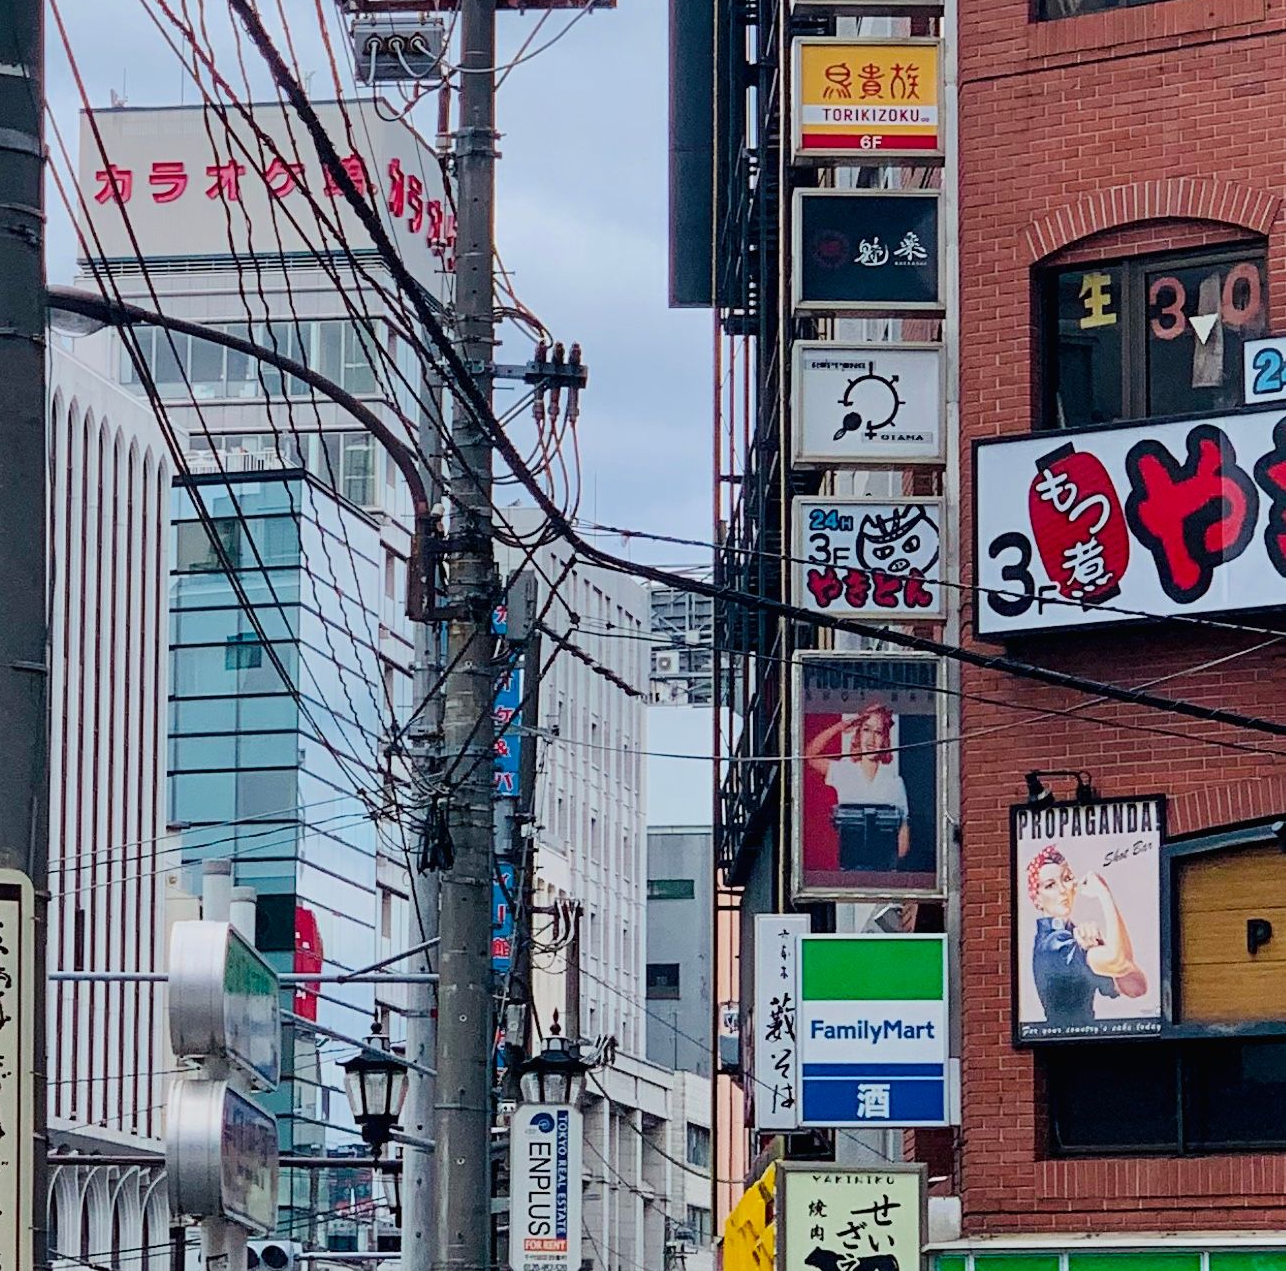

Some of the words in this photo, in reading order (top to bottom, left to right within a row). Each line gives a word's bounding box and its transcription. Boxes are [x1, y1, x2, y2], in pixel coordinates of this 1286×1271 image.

[822, 62, 920, 100] 鳥貴族
[822, 108, 920, 122] TORIKIZOKU
[859, 135, 882, 149] 6F
[1078, 271, 1118, 330] 生
[808, 507, 854, 531] 24H
[1035, 468, 1114, 598] もつ煮
[808, 532, 852, 565] 3F
[807, 566, 934, 609] やきとん
[987, 531, 1060, 618] 3F
[810, 1019, 936, 1045] FamilyMart
[856, 1083, 891, 1120] 酒
[527, 1141, 552, 1237] ENPLUS
[812, 1175, 896, 1185] YAKINIKU
[808, 1198, 828, 1242] 焼肉
